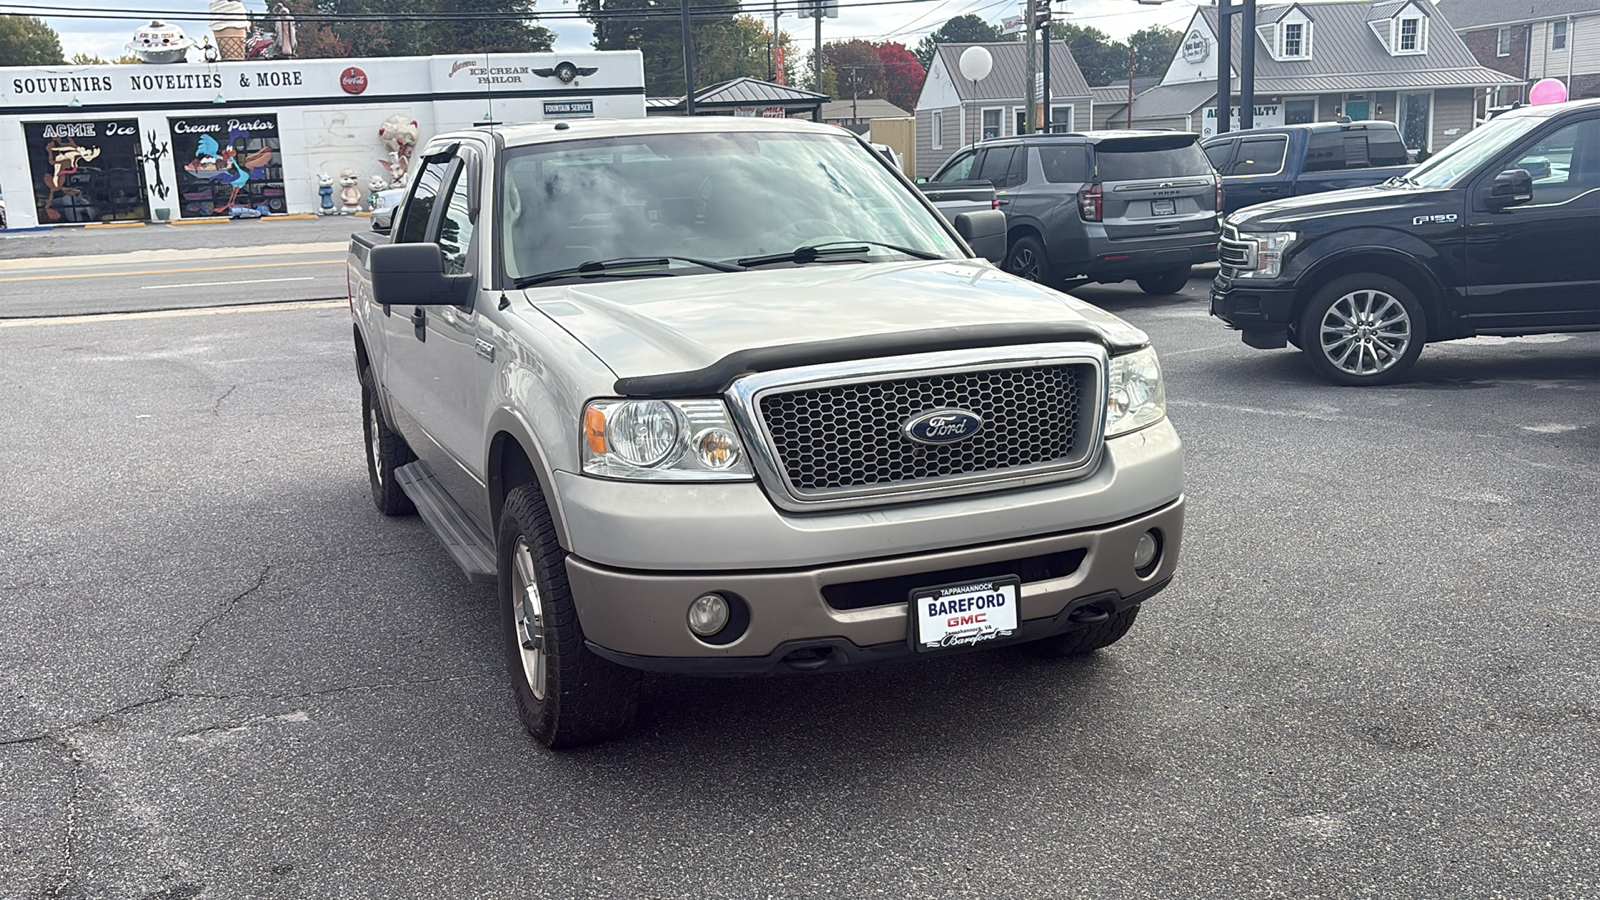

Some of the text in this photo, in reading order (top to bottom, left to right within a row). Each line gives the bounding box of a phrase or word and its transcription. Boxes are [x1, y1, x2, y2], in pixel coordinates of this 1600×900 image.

[469, 67, 529, 76] ICE CREAM
[13, 71, 302, 94] SOUVENIRS NOVELTIES & MORE
[478, 76, 522, 84] PARLOR
[545, 103, 592, 113] FOUNTAIN SERVICE
[43, 122, 136, 138] ACME Ice
[174, 118, 275, 134] Cream Parlor
[925, 415, 967, 437] Ford
[940, 582, 993, 596] TAPPAHANNOCK
[928, 593, 1005, 617] BAREFORD
[947, 613, 987, 627] GMC
[941, 627, 999, 647] Bareford
